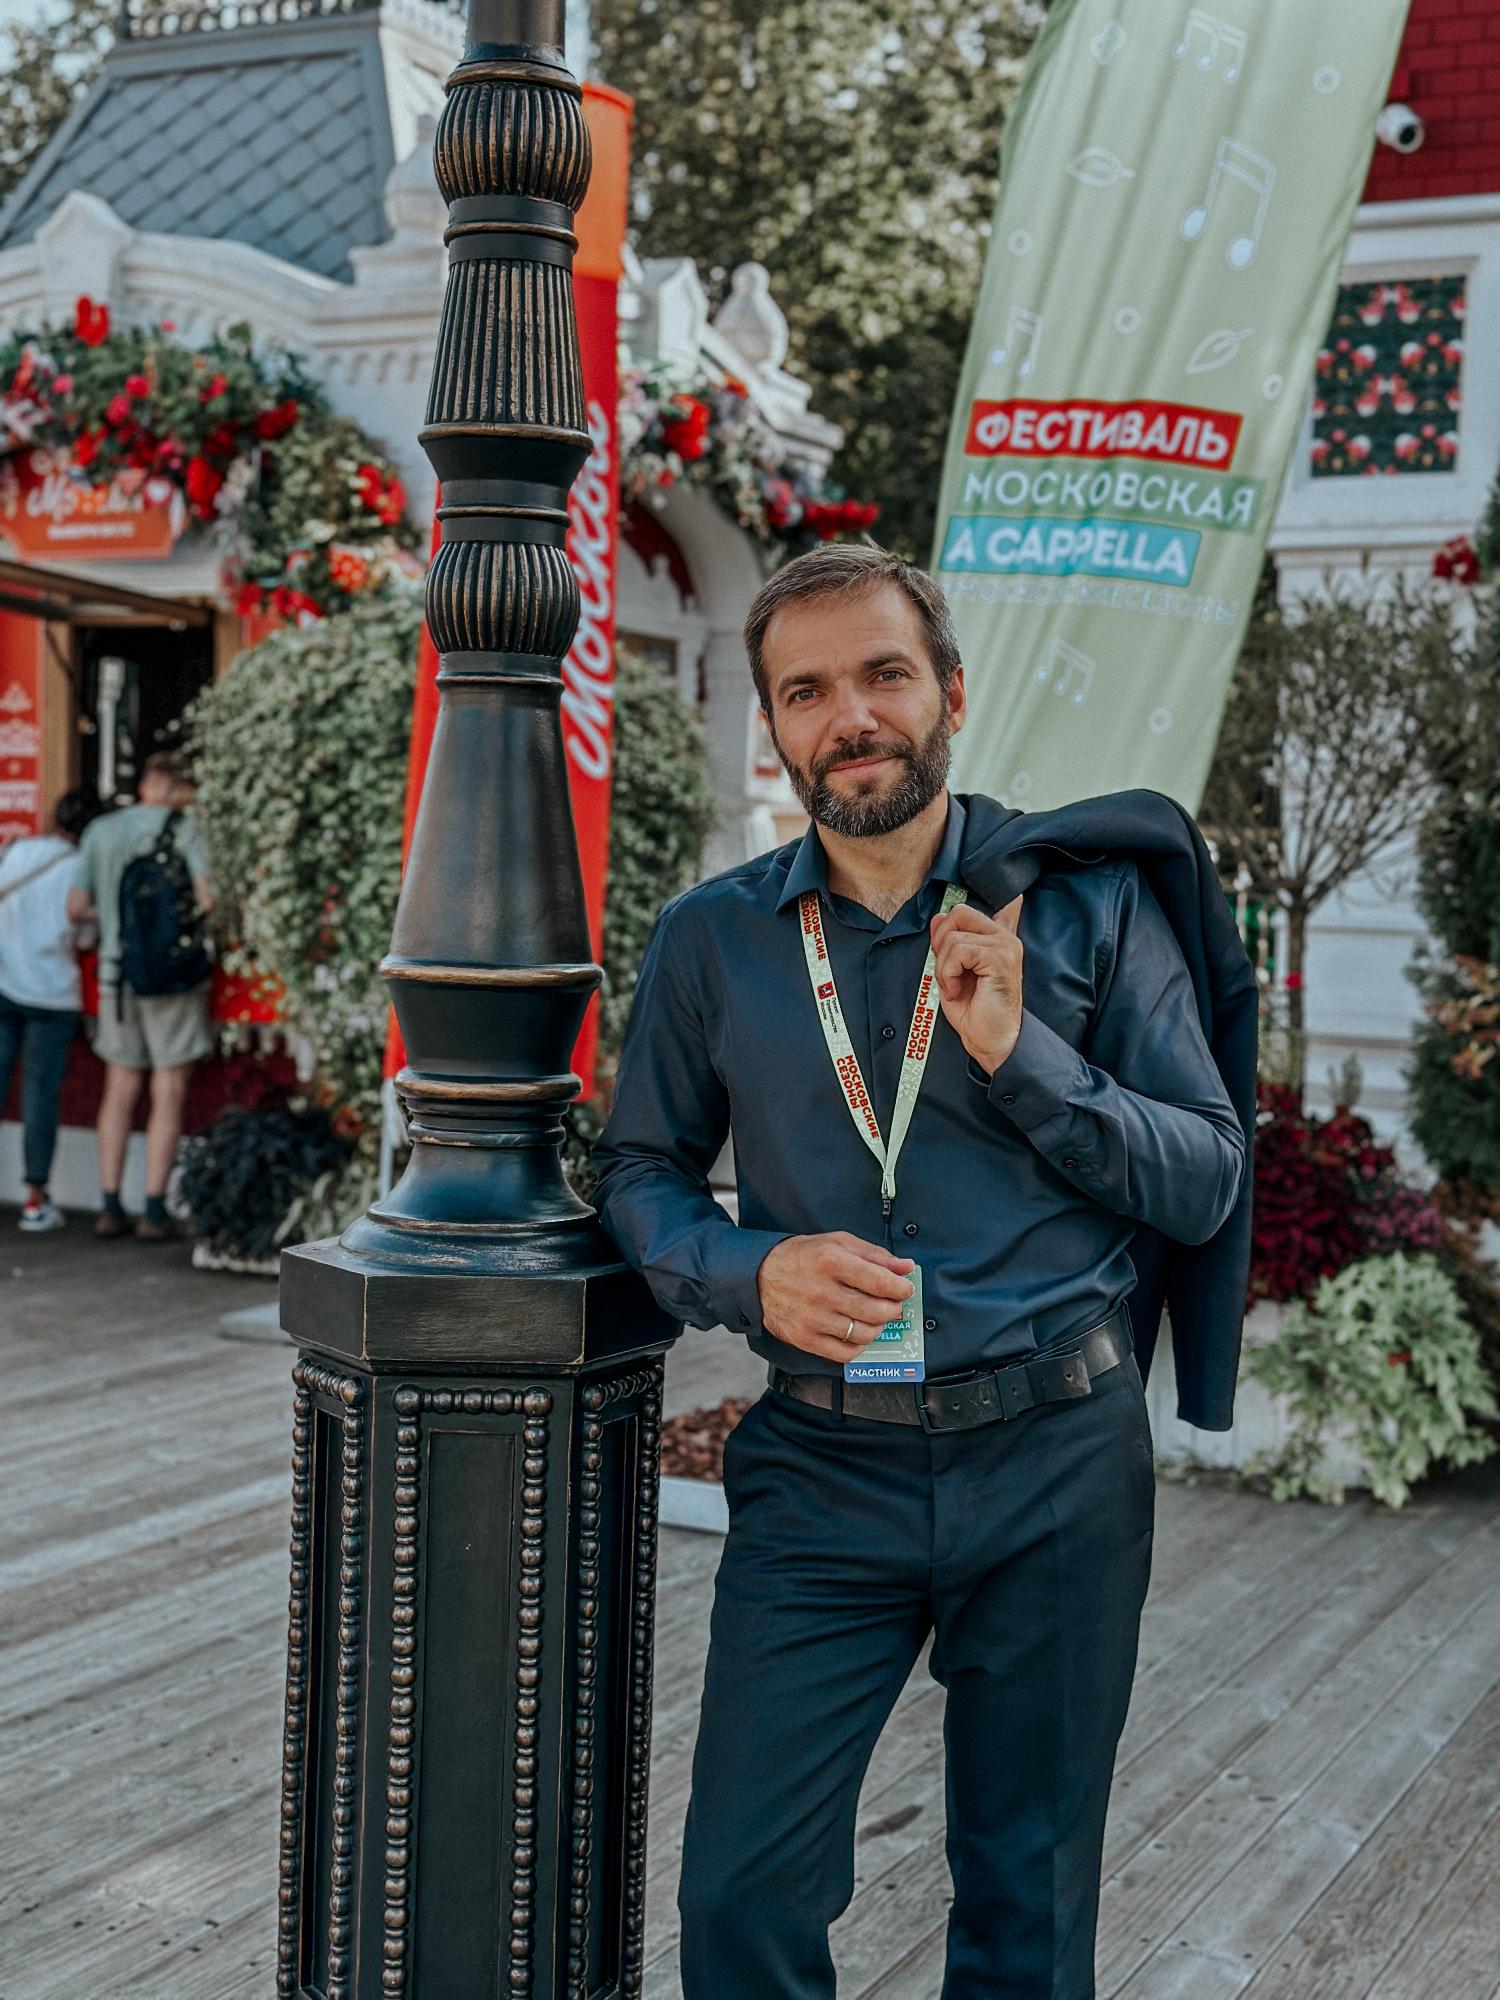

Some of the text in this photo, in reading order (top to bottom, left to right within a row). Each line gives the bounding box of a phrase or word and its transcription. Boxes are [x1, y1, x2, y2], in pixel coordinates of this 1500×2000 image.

[974, 408, 1230, 462] ФЕСТИВАЛЬ
[963, 469, 1256, 525] МОСКОВСКАЯ
[945, 526, 1188, 580] A CAPPELLA
[800, 895, 812, 935] ЕЗОНЫ
[906, 974, 933, 1059] МОСКОВСКИЕ
[915, 1008, 935, 1061] СЕЗОНЫ
[836, 1058, 860, 1109] СЕЗОНЫ
[845, 1055, 879, 1139] МОСКОВСКИЕ
[849, 1368, 900, 1378] УЧАСТНИК
